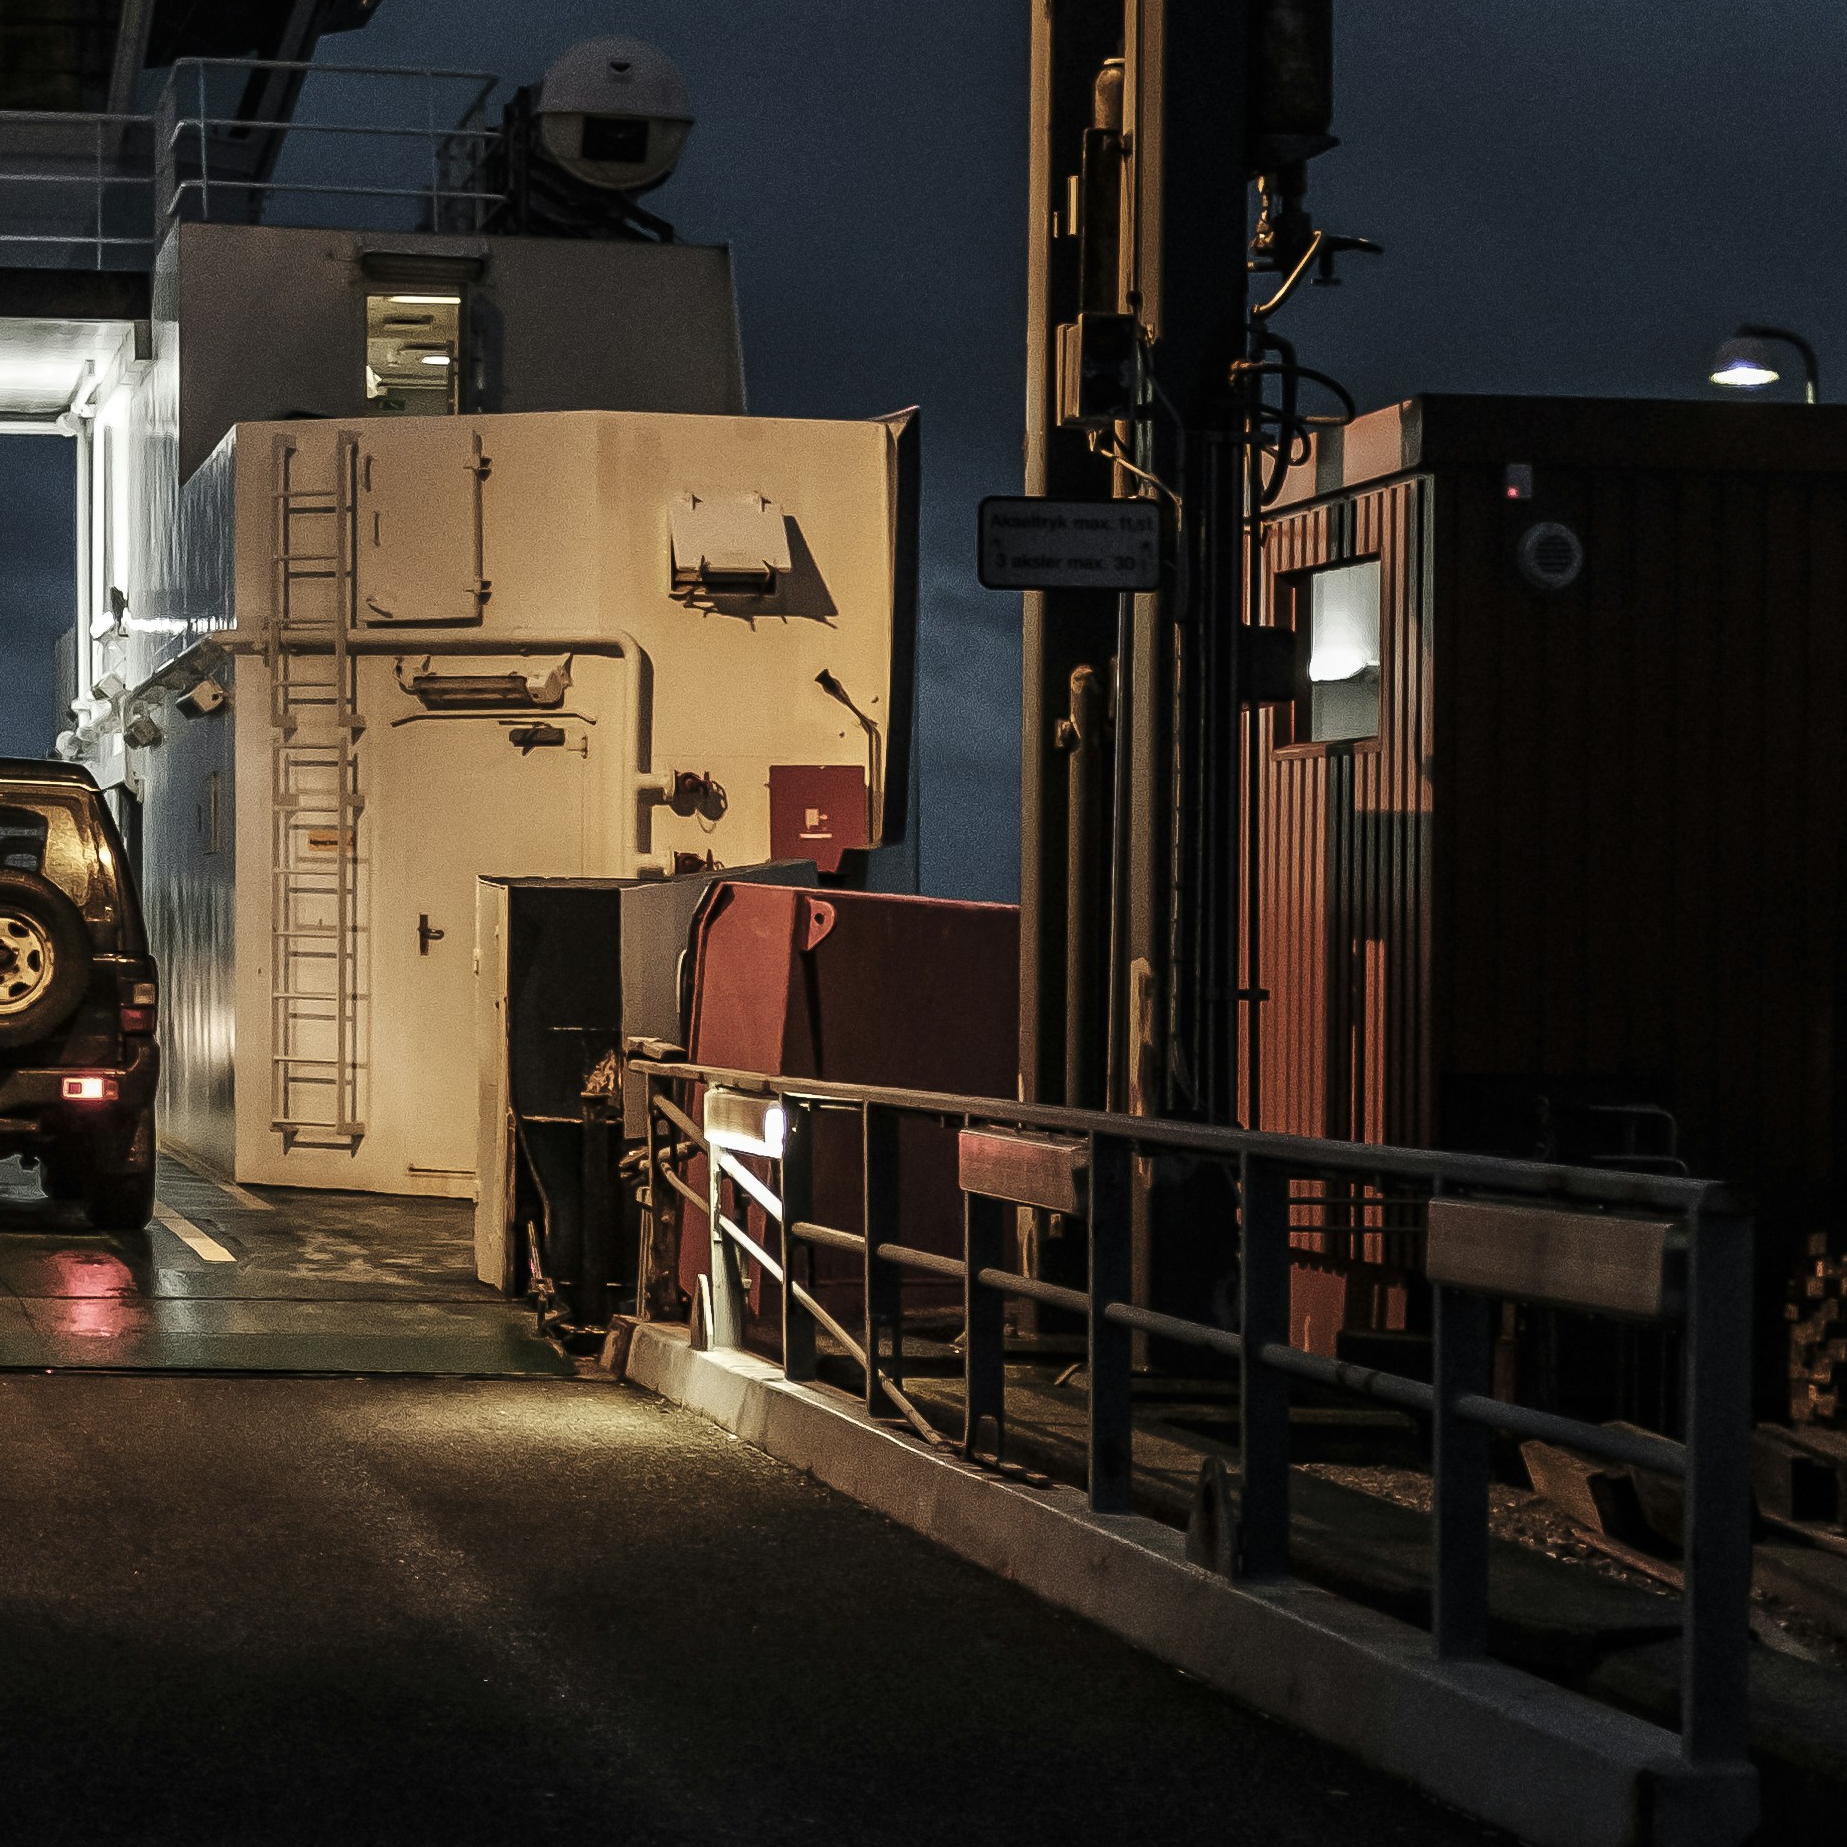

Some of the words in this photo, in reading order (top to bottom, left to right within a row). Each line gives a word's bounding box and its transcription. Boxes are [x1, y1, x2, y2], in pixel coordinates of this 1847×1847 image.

[990, 514, 1067, 532] Akseltryk
[995, 553, 1007, 568] 3
[1011, 554, 1062, 569] aksler
[1114, 555, 1137, 571] 30
